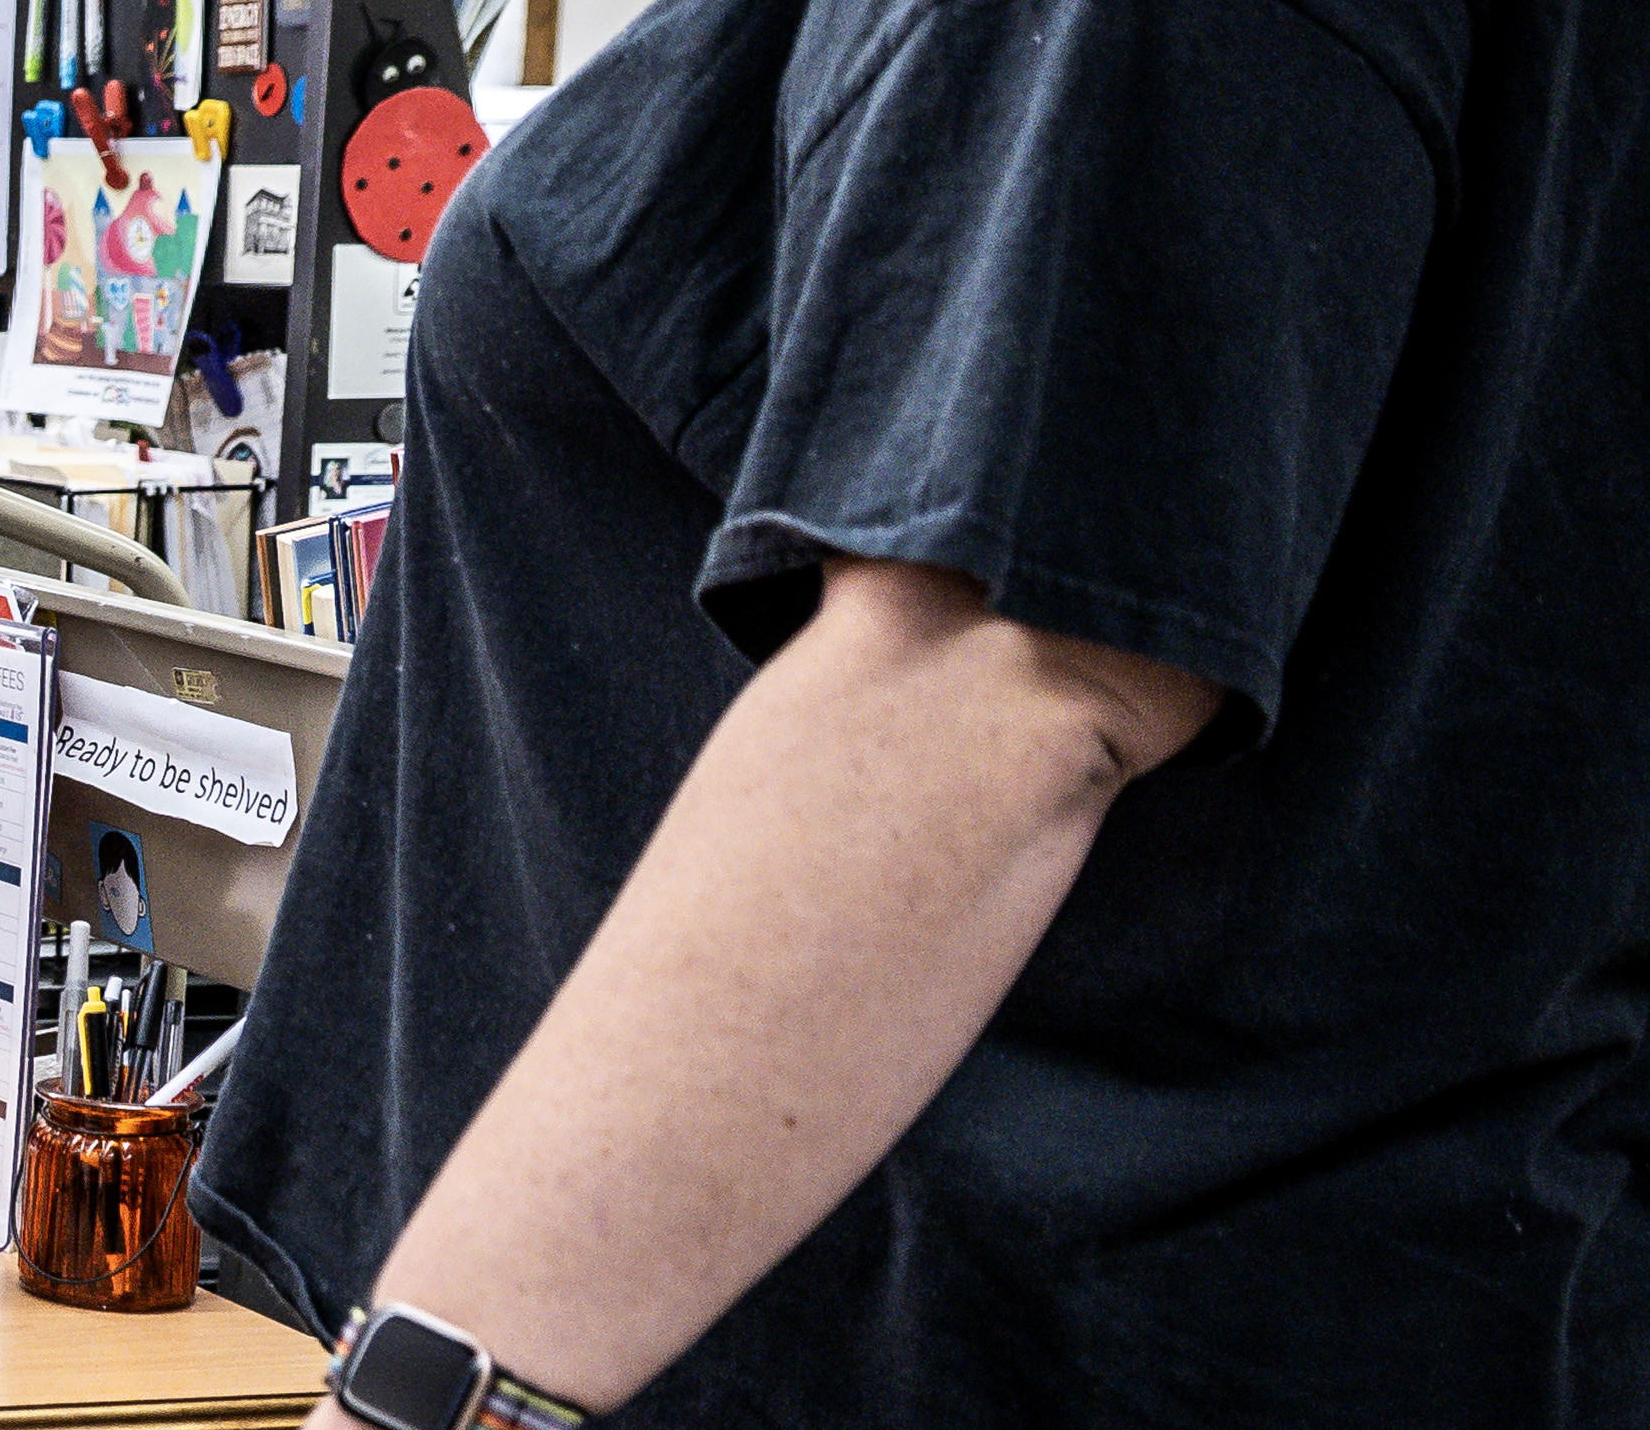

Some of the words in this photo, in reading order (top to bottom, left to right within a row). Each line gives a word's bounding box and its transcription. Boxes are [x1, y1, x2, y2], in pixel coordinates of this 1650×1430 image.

[56, 725, 128, 778] Ready
[129, 748, 156, 782] to
[159, 753, 191, 794] be
[194, 767, 288, 825] shelved
